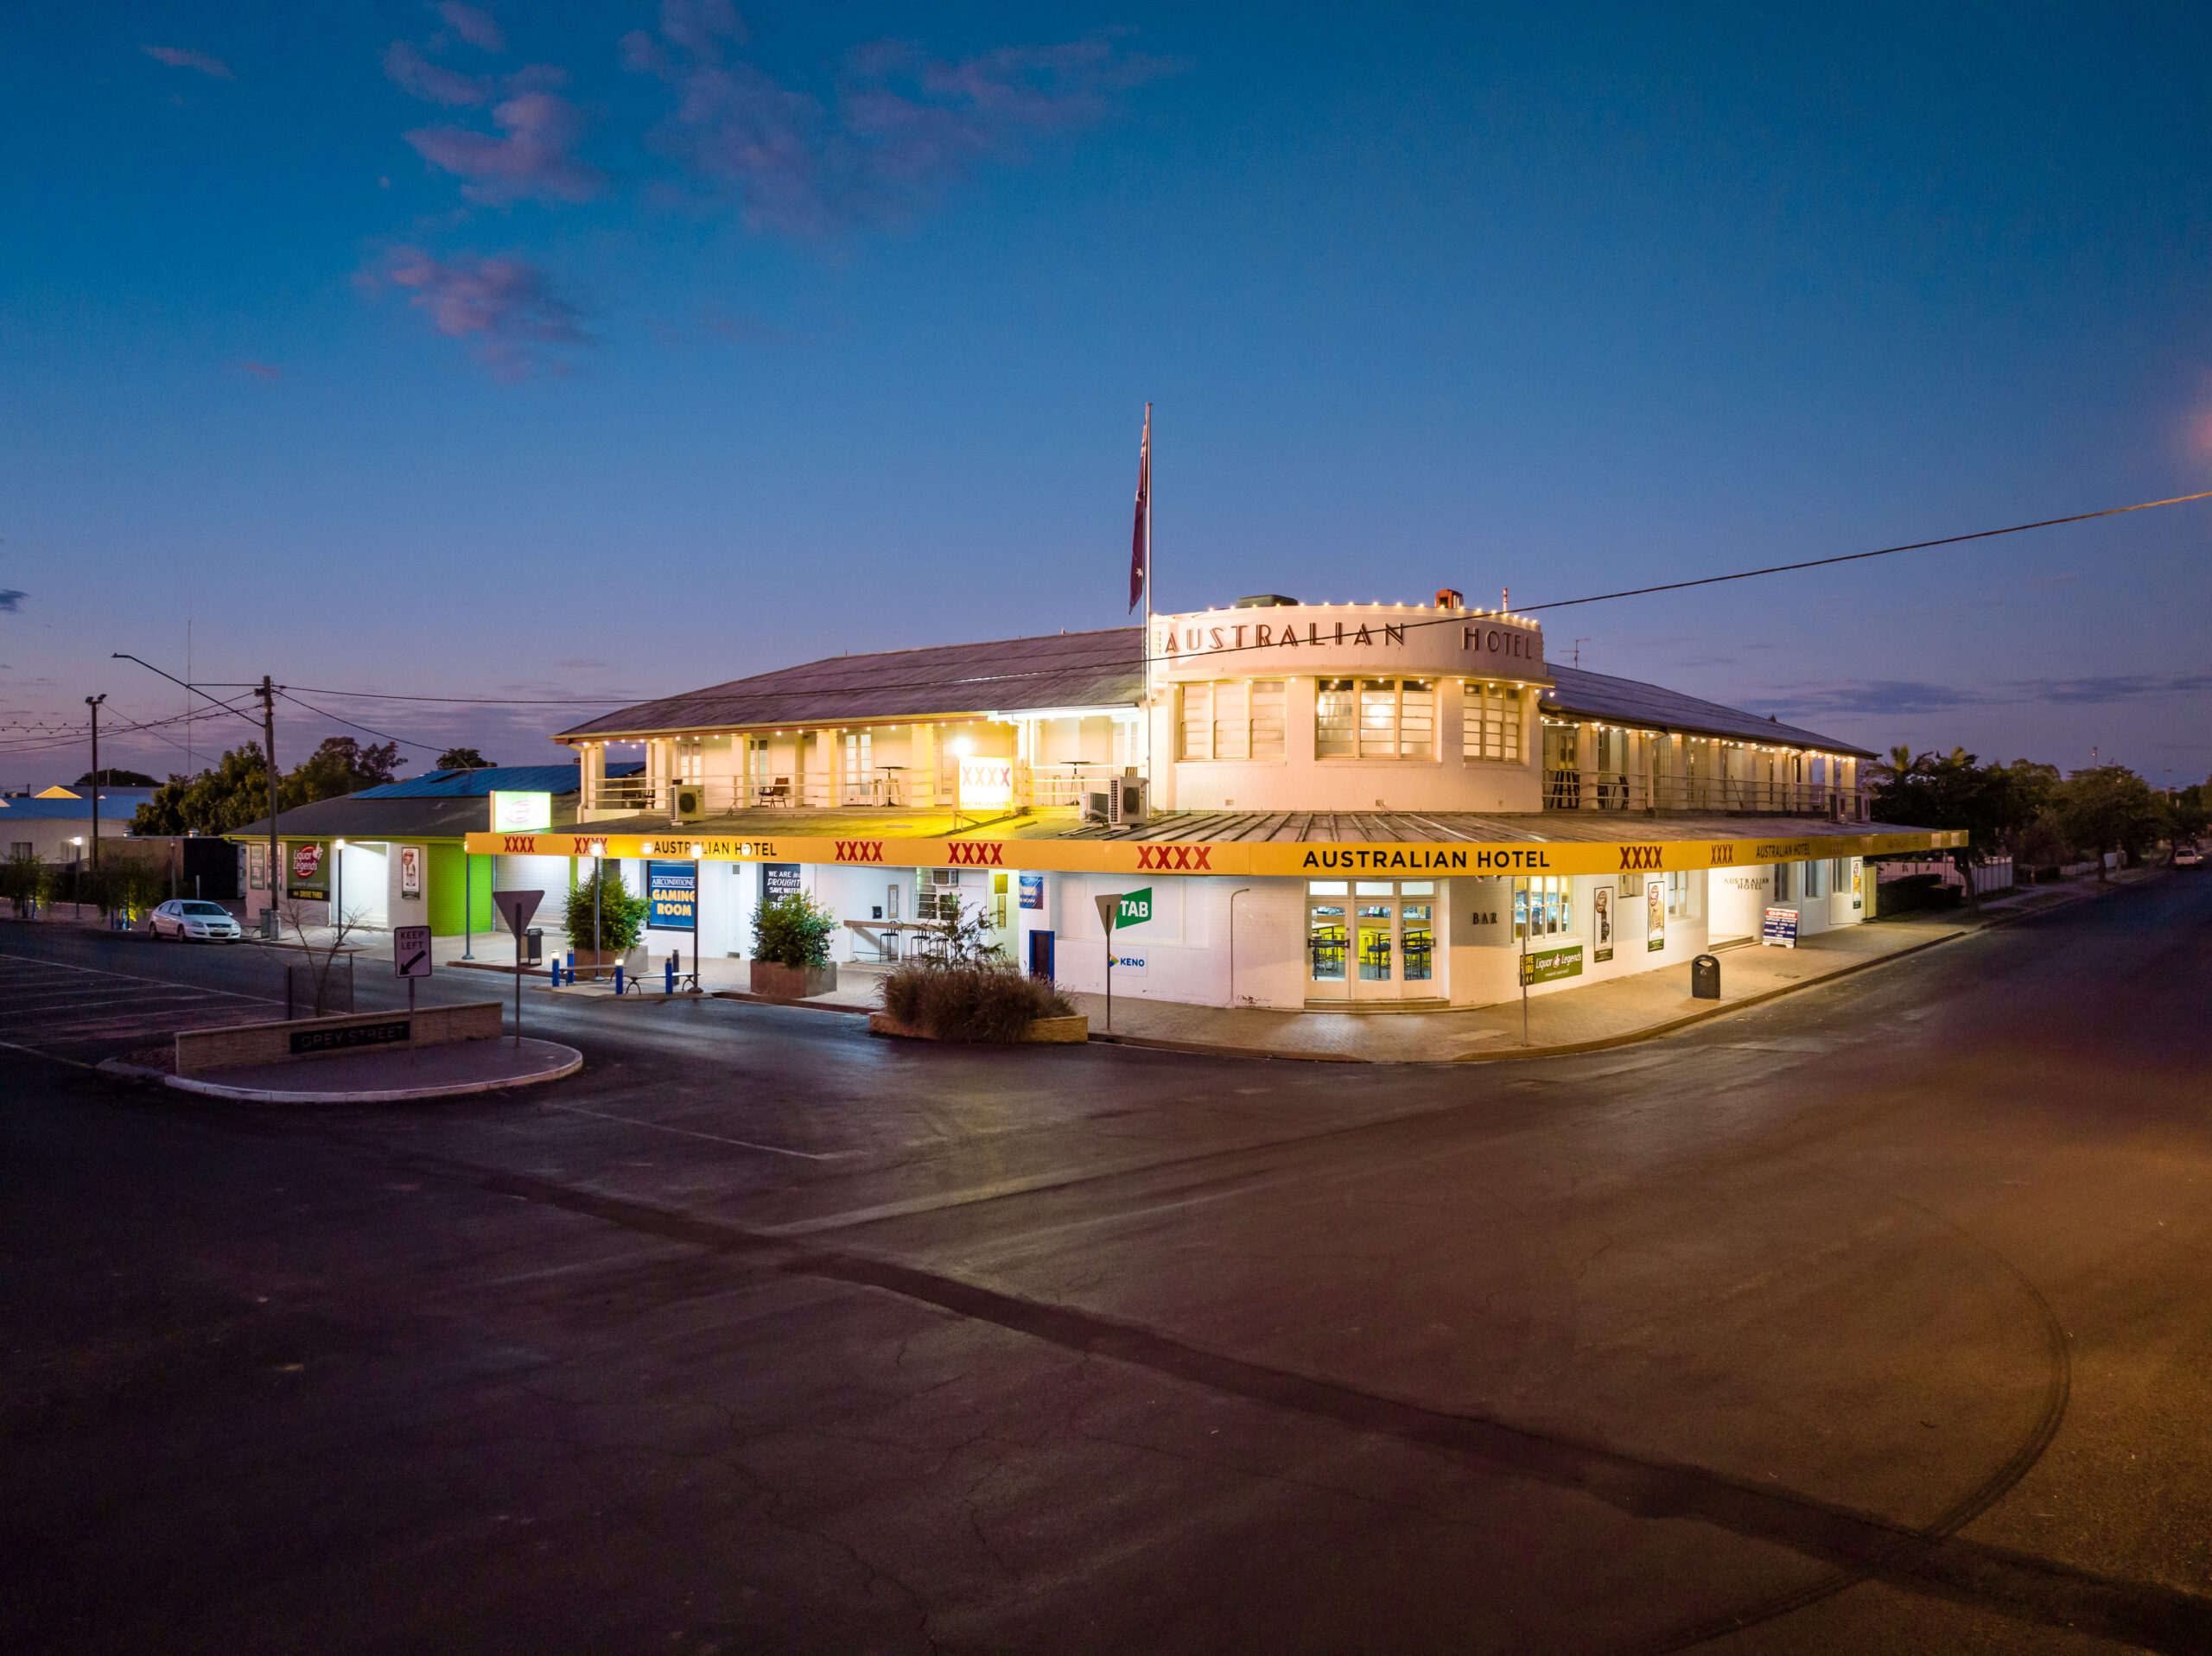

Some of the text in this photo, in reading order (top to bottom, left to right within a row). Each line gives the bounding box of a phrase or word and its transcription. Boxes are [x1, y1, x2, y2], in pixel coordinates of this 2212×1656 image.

[1165, 622, 1532, 659] AUSTRALIAN HOTEL
[962, 766, 1010, 787] XXXX
[504, 836, 535, 853] XXXX
[654, 841, 729, 855] AUSTRLIAN
[835, 841, 883, 861] XXXX
[1756, 842, 1811, 859] AUSTRALIAN HOTEL
[293, 849, 313, 862] Liquor
[948, 843, 1003, 865] XXXX
[1136, 846, 1211, 871] XXXX
[1303, 851, 1550, 868] AUSTRALIAN HOTEL
[1619, 846, 1662, 869] XXXX
[1710, 843, 1734, 865] XXXX
[293, 860, 318, 872] Legends
[652, 878, 695, 886] AIRCONDITIONE
[652, 889, 695, 902] GAMING
[657, 903, 691, 916] ROOM
[1121, 900, 1148, 917] TAB
[1472, 912, 1497, 924] BAR
[401, 942, 423, 950] LEFT
[1120, 958, 1145, 967] KENO
[1535, 957, 1553, 971] Liquor
[1561, 951, 1582, 966] Legends
[301, 1025, 406, 1048] GREY STREET
